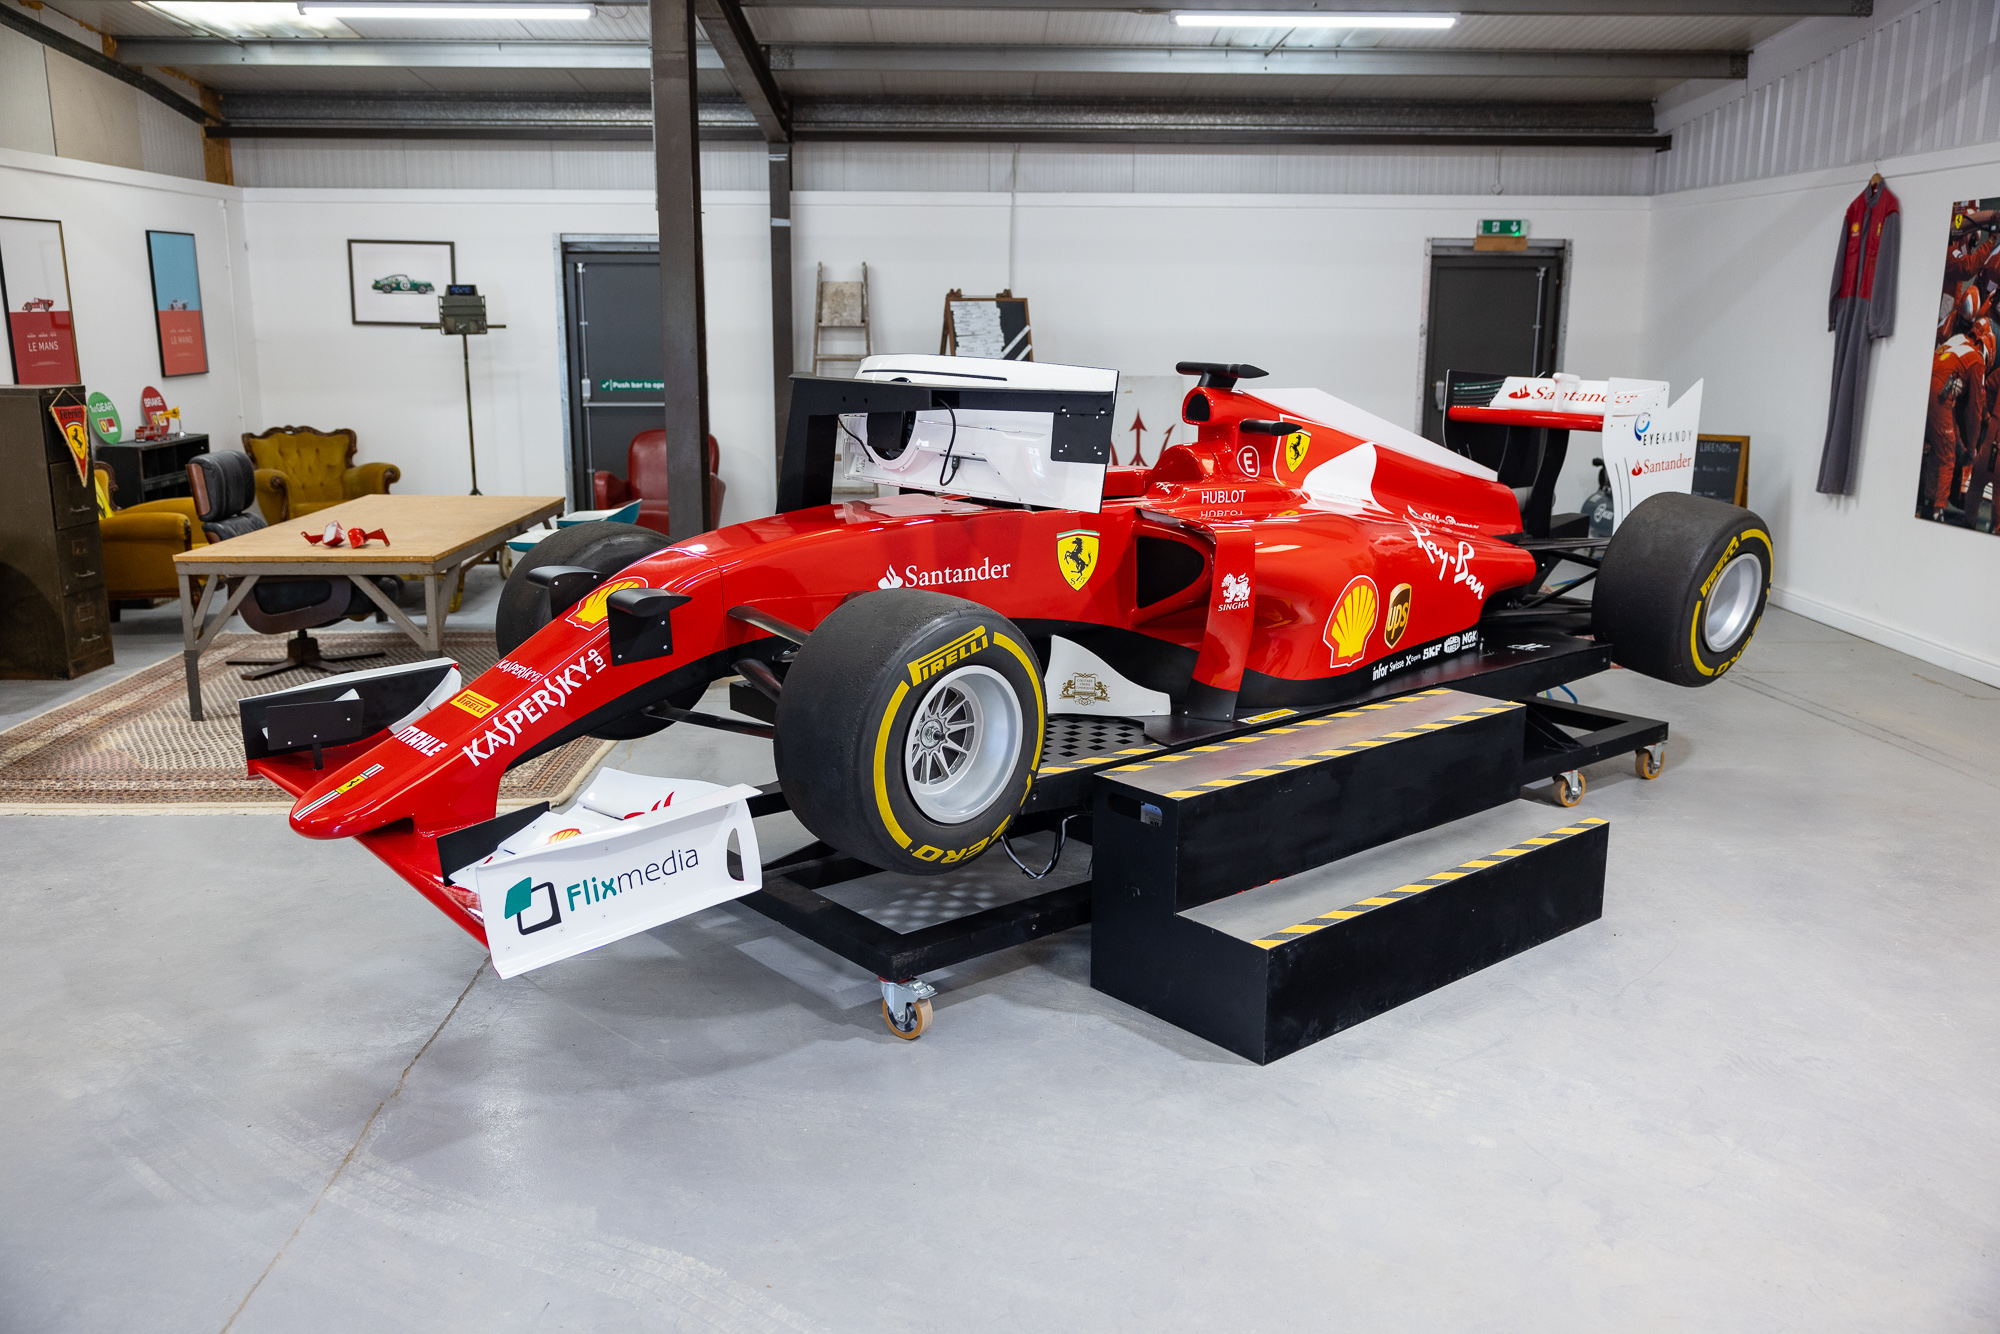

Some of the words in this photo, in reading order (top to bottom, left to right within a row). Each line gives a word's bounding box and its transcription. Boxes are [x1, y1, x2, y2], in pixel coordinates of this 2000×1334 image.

[28, 342, 37, 352] LE
[38, 341, 59, 351] MANS
[631, 381, 643, 389] bar
[644, 381, 652, 389] to
[1243, 452, 1256, 473] E
[1643, 452, 1693, 475] Santander
[1201, 489, 1247, 504] HUBLOT
[905, 556, 1011, 588] Santander
[1217, 600, 1250, 612] SINGHA
[1385, 601, 1410, 640] ups
[1461, 630, 1477, 645] NGK
[907, 625, 989, 687] PIRELLI
[1372, 663, 1389, 681] infor
[1422, 643, 1442, 660] SKF
[456, 692, 492, 714] PIRELLI
[461, 656, 592, 767] KASPERSKY
[394, 725, 448, 757] MAHLE
[566, 848, 699, 912] Flixmedia
